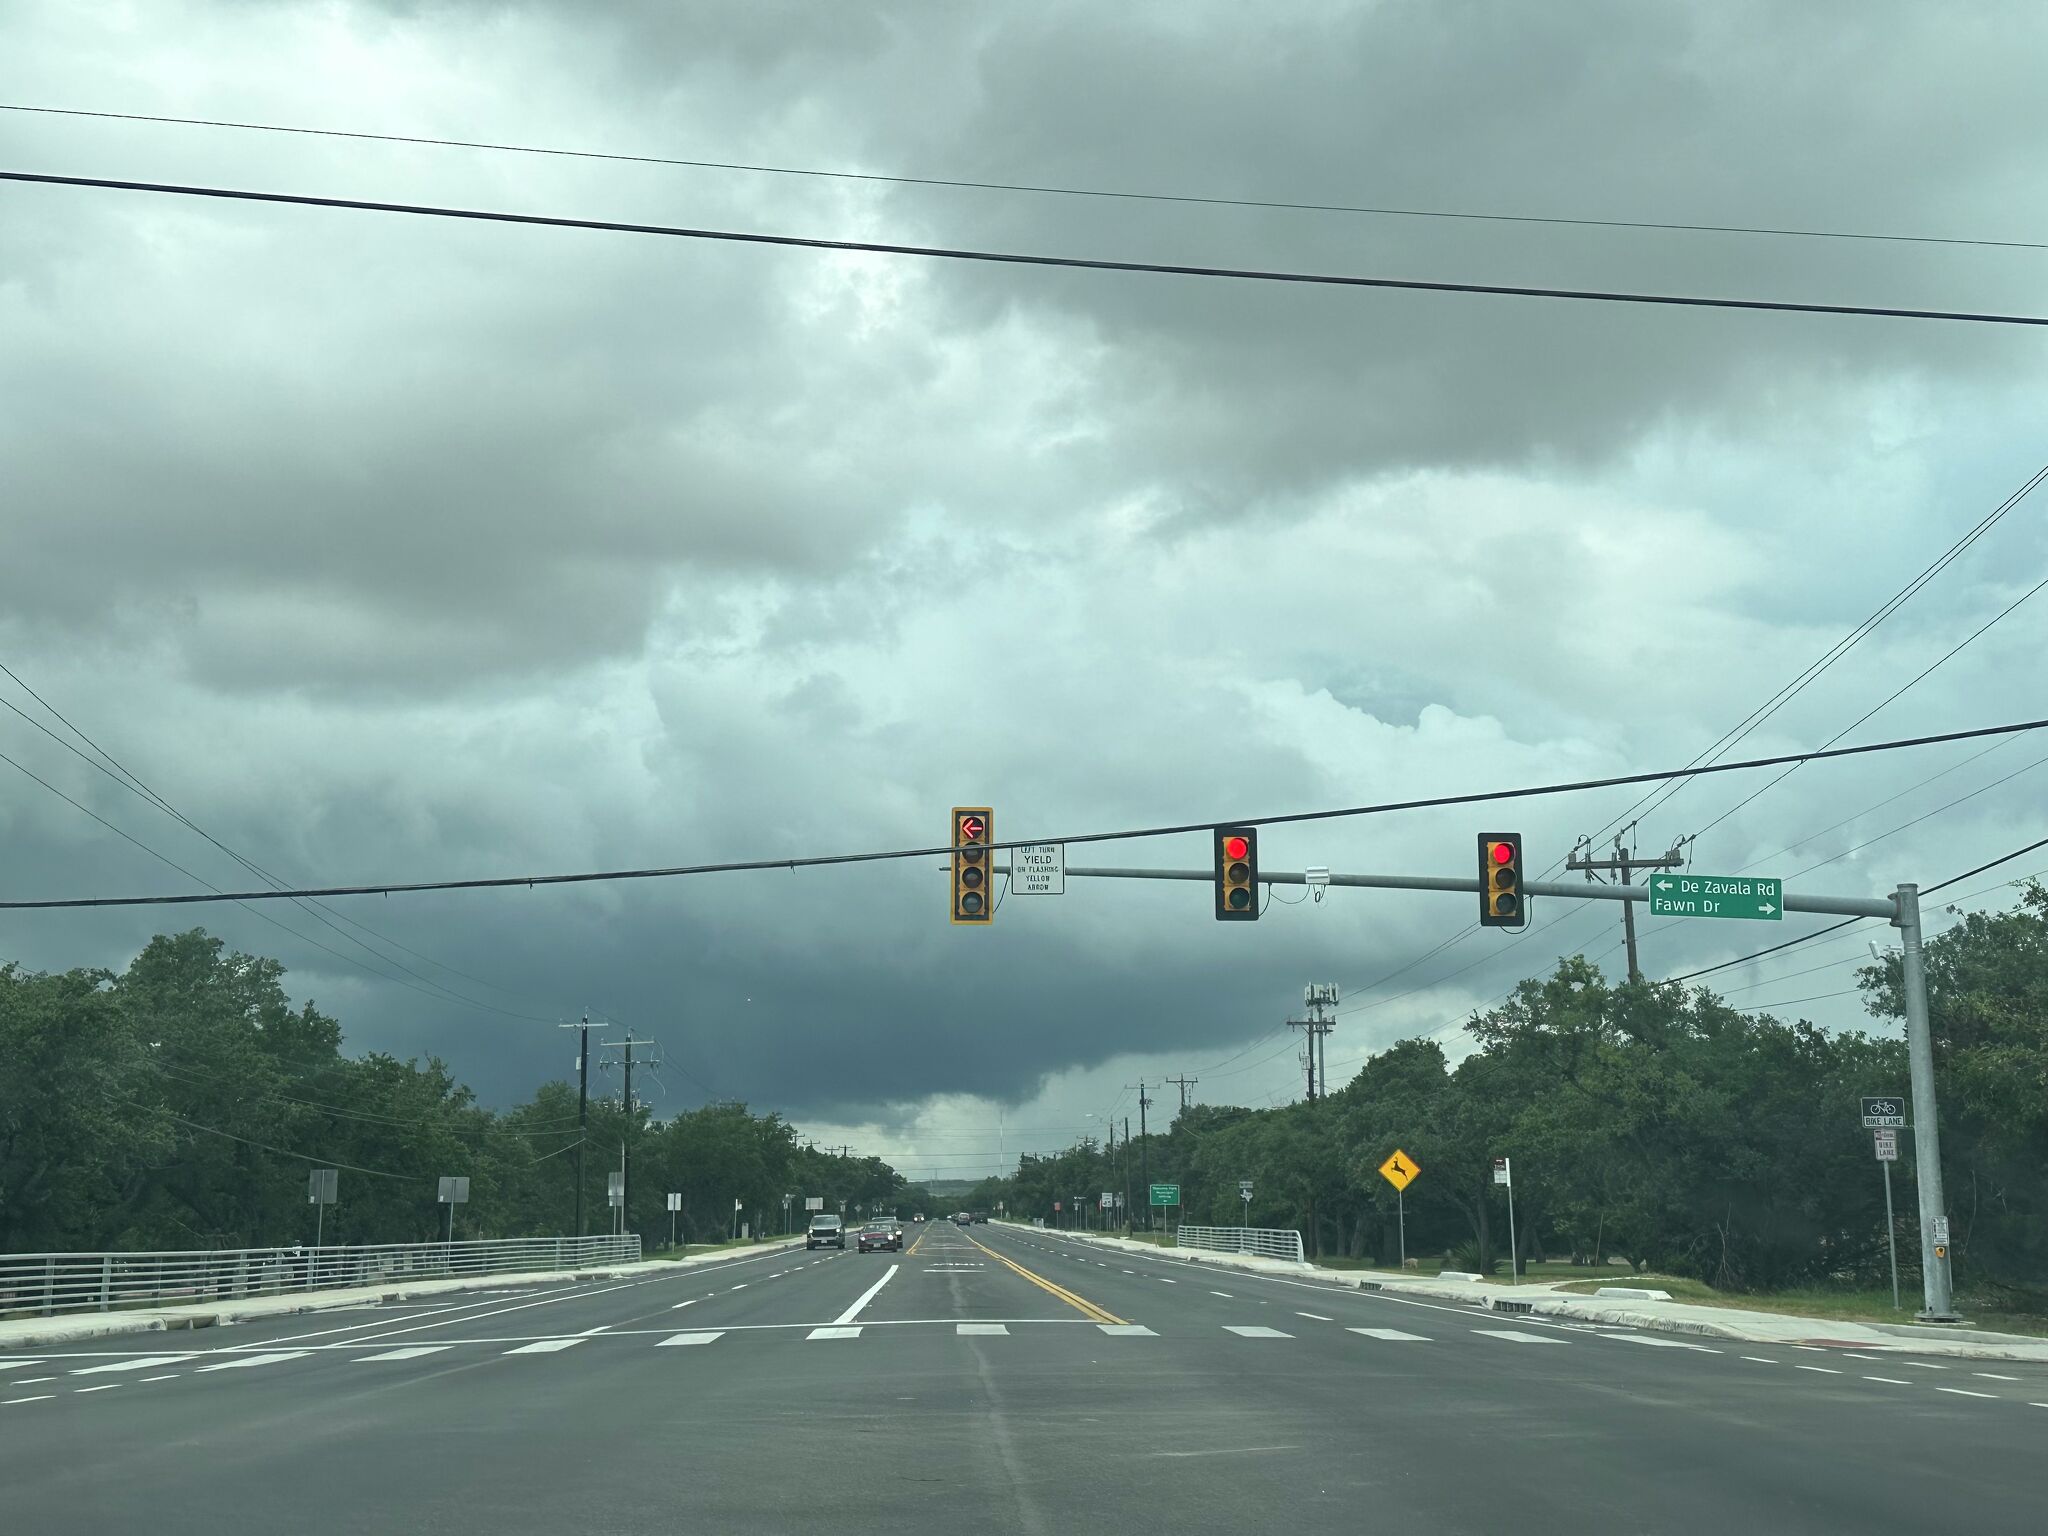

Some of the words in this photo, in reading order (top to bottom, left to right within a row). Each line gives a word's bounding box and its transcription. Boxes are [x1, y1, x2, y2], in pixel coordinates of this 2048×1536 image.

[1024, 856, 1052, 864] YIELD
[1681, 880, 1699, 893] De
[1704, 881, 1751, 895] Zavala
[1757, 882, 1775, 896] Rd
[1656, 898, 1695, 912] Fawn
[1703, 900, 1720, 913] Dr
[1866, 1118, 1882, 1126] BIKE
[1884, 1118, 1902, 1126] LANE
